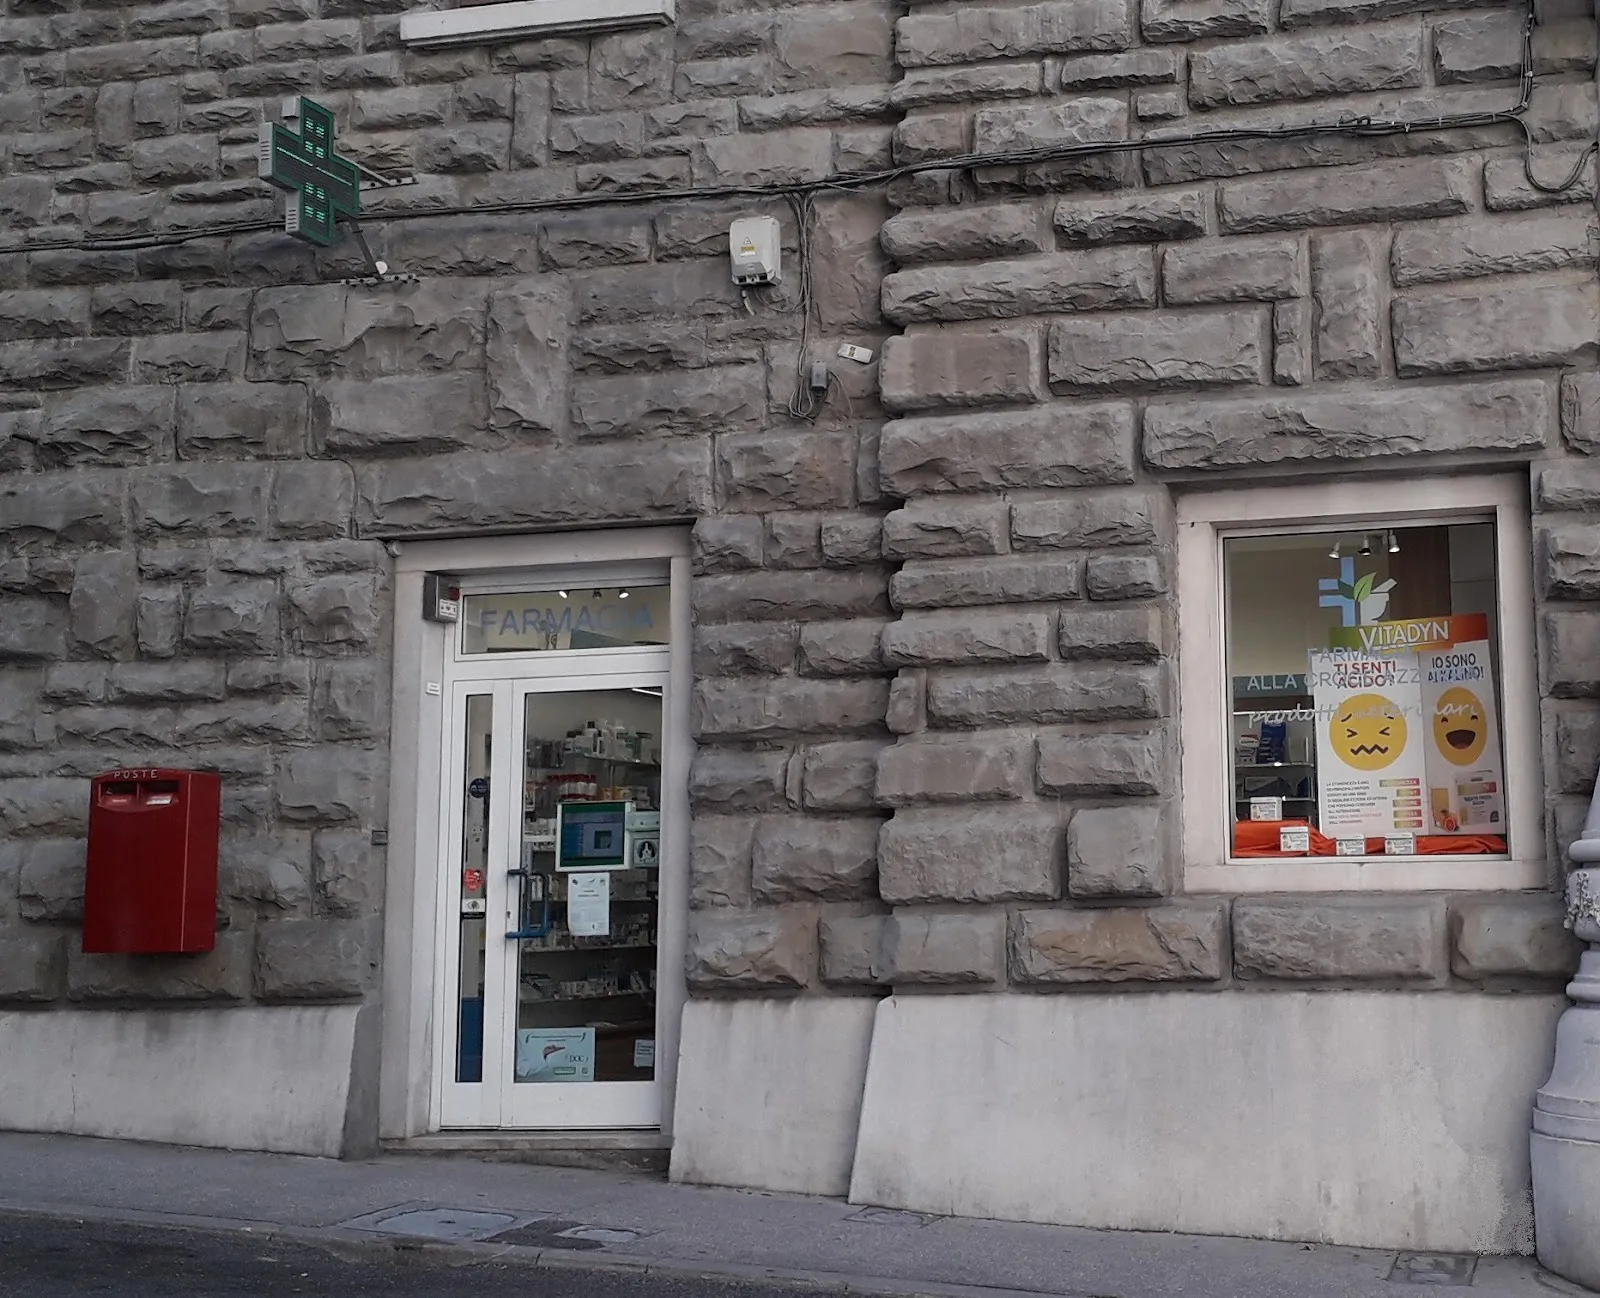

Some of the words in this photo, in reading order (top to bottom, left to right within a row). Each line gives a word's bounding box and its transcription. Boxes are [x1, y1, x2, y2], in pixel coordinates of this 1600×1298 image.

[480, 601, 654, 637] FARMACIA
[1358, 620, 1449, 653] VITADYN
[1333, 662, 1347, 675] TI
[1351, 660, 1396, 675] SENTI
[1432, 656, 1443, 669] IO
[1445, 652, 1476, 668] SONO
[1247, 673, 1298, 691] ALLA
[1247, 701, 1342, 729] prodott
[114, 769, 158, 779] POSTE
